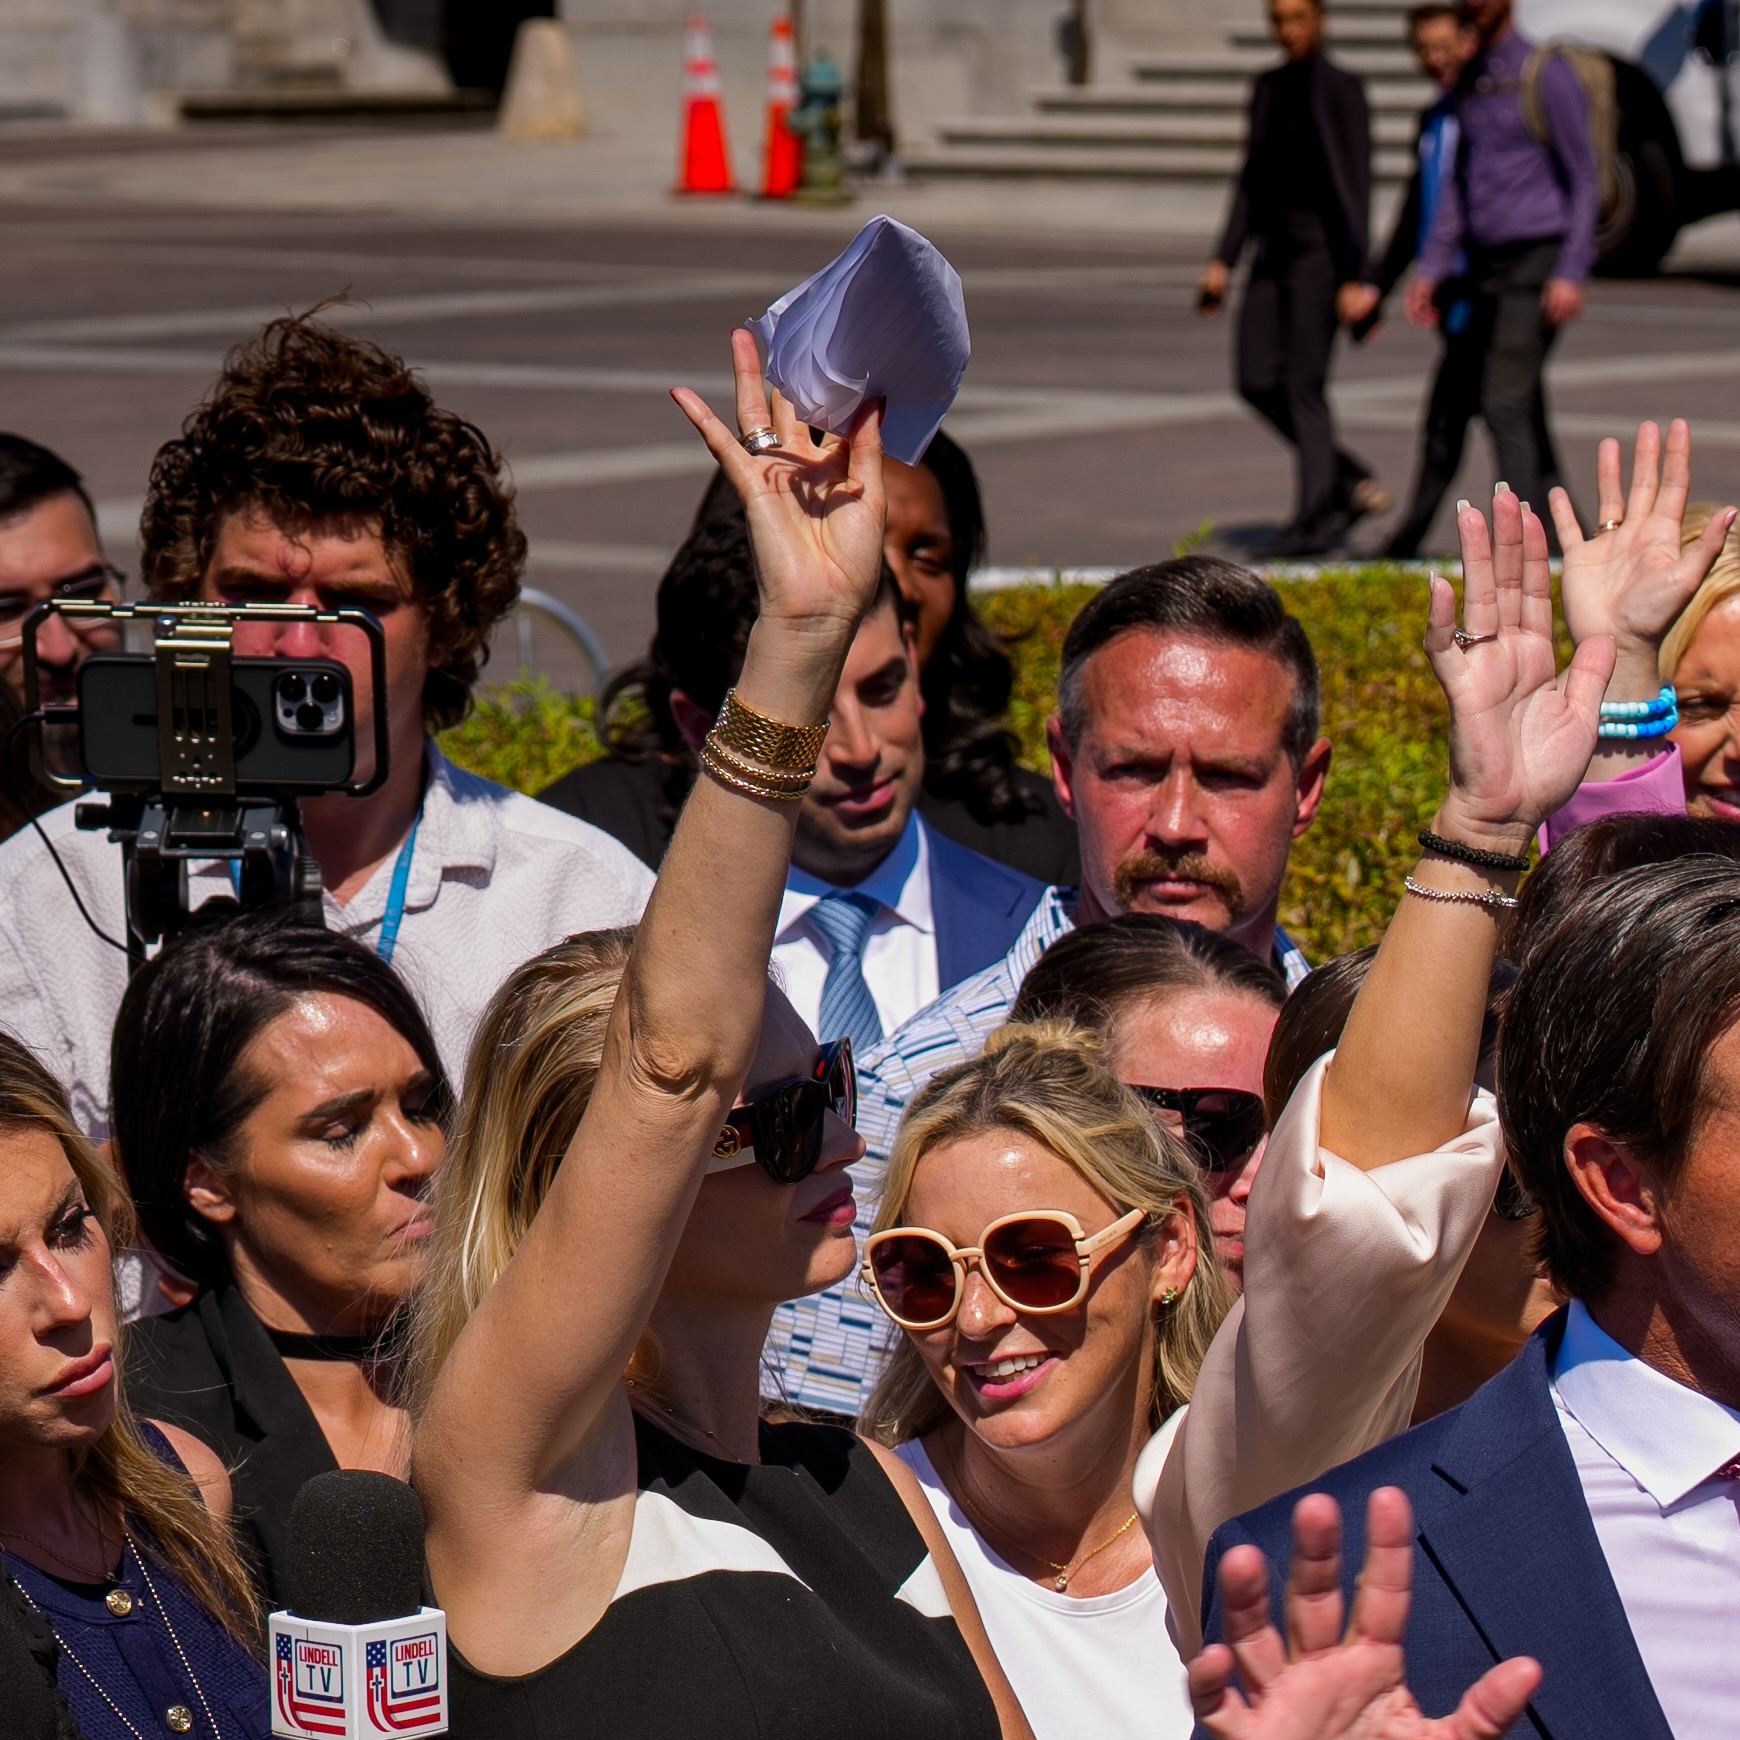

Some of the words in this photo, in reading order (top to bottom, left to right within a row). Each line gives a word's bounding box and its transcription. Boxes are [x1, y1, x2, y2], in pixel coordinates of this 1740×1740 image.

[299, 1645, 338, 1667] LINDELL
[394, 1640, 434, 1662] LINDELL
[306, 1664, 331, 1692] TV
[403, 1658, 428, 1687] TV
